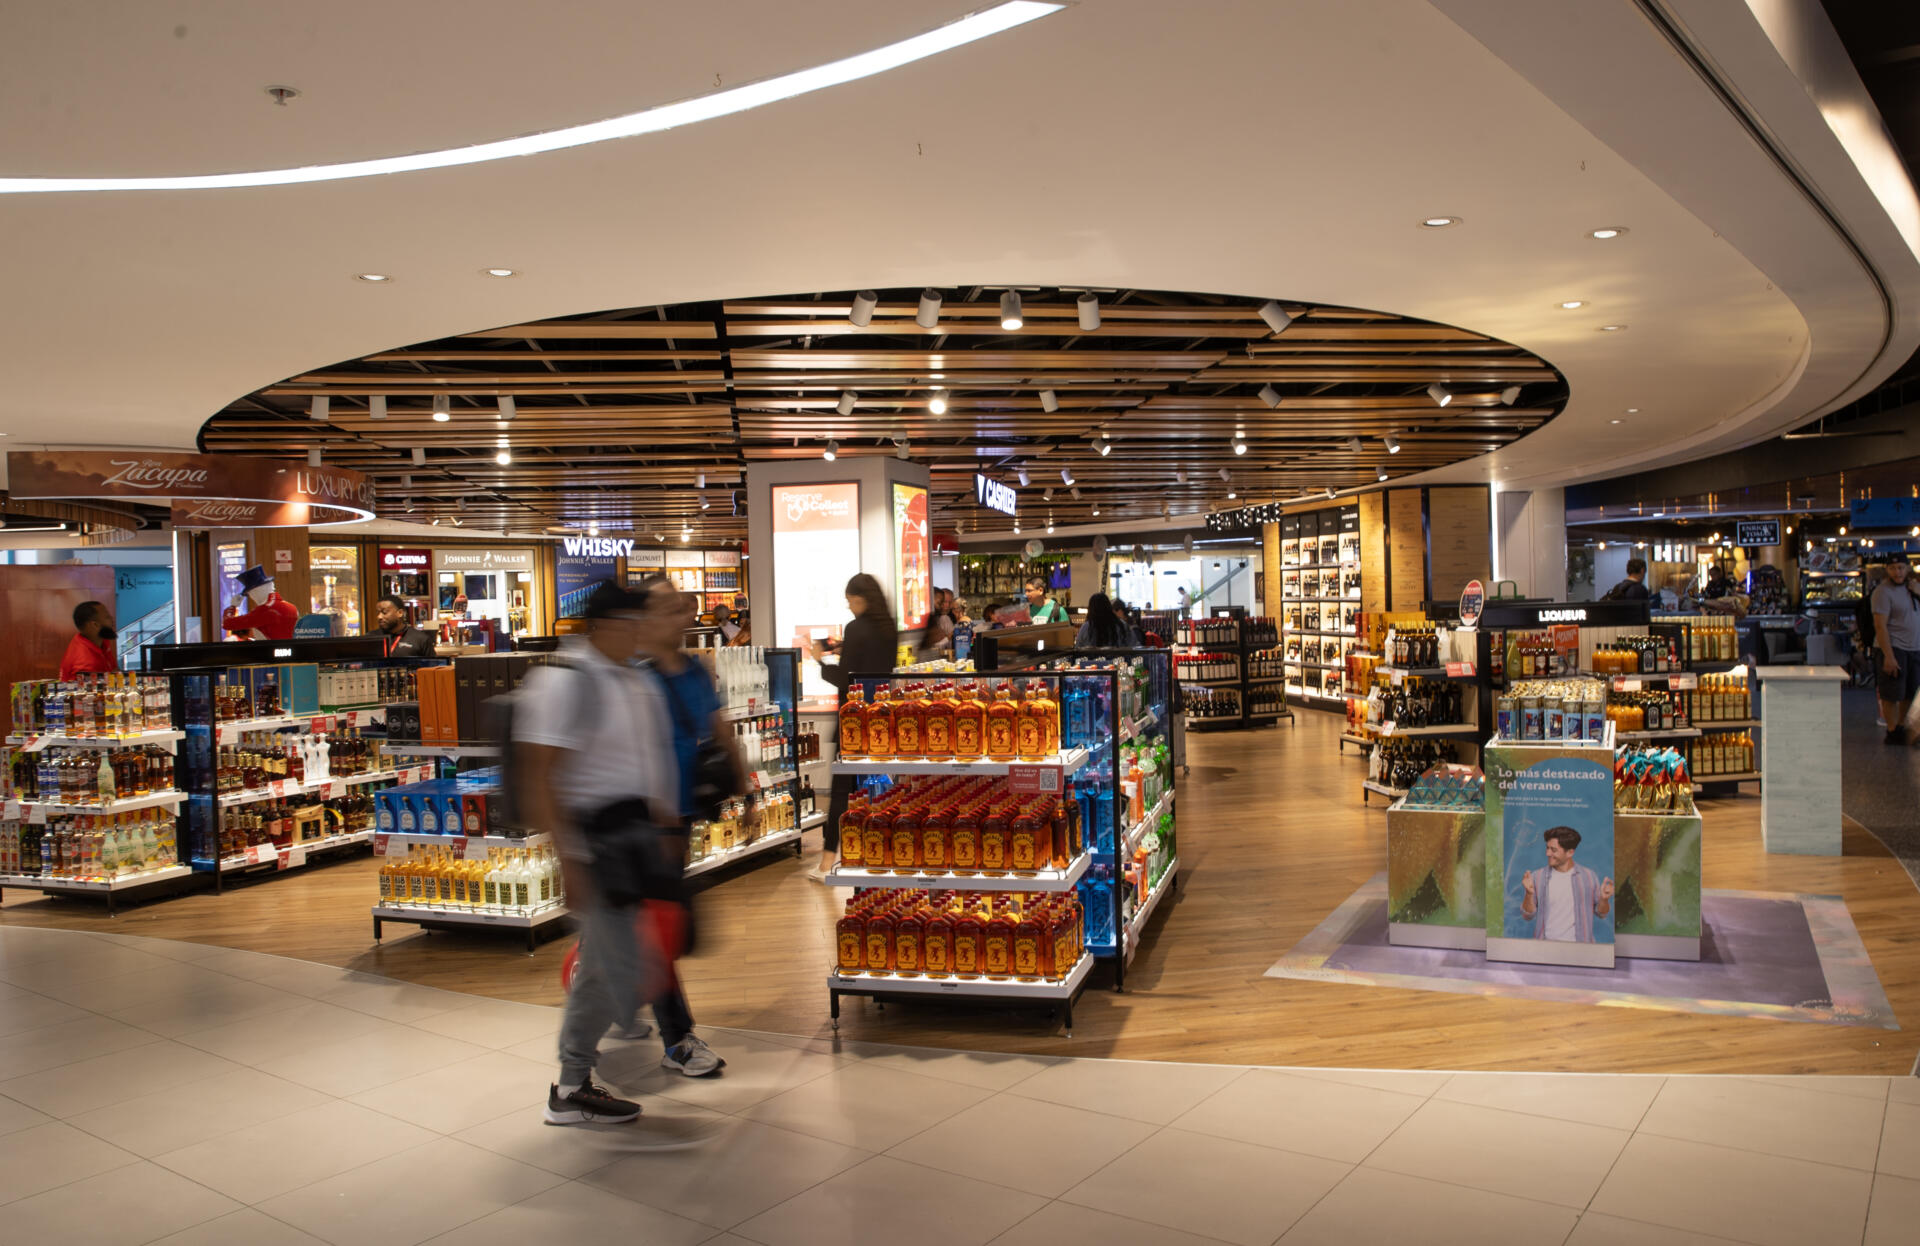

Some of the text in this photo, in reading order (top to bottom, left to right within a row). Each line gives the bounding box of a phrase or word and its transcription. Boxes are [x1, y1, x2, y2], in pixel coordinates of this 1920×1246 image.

[101, 459, 208, 489] Zacapa
[297, 471, 355, 500] LUXURY
[986, 478, 1016, 516] CASHIER
[186, 499, 257, 521] Zacapa
[563, 538, 635, 557] WHISKY
[396, 555, 427, 564] CHIVAS
[444, 554, 526, 564] JOHNNIE WALKER
[558, 556, 614, 566] JOHNNIE WALKER
[1538, 609, 1587, 622] LIQUEUR
[1498, 768, 1605, 779] Lo más destacado
[1498, 780, 1561, 791] del verano
